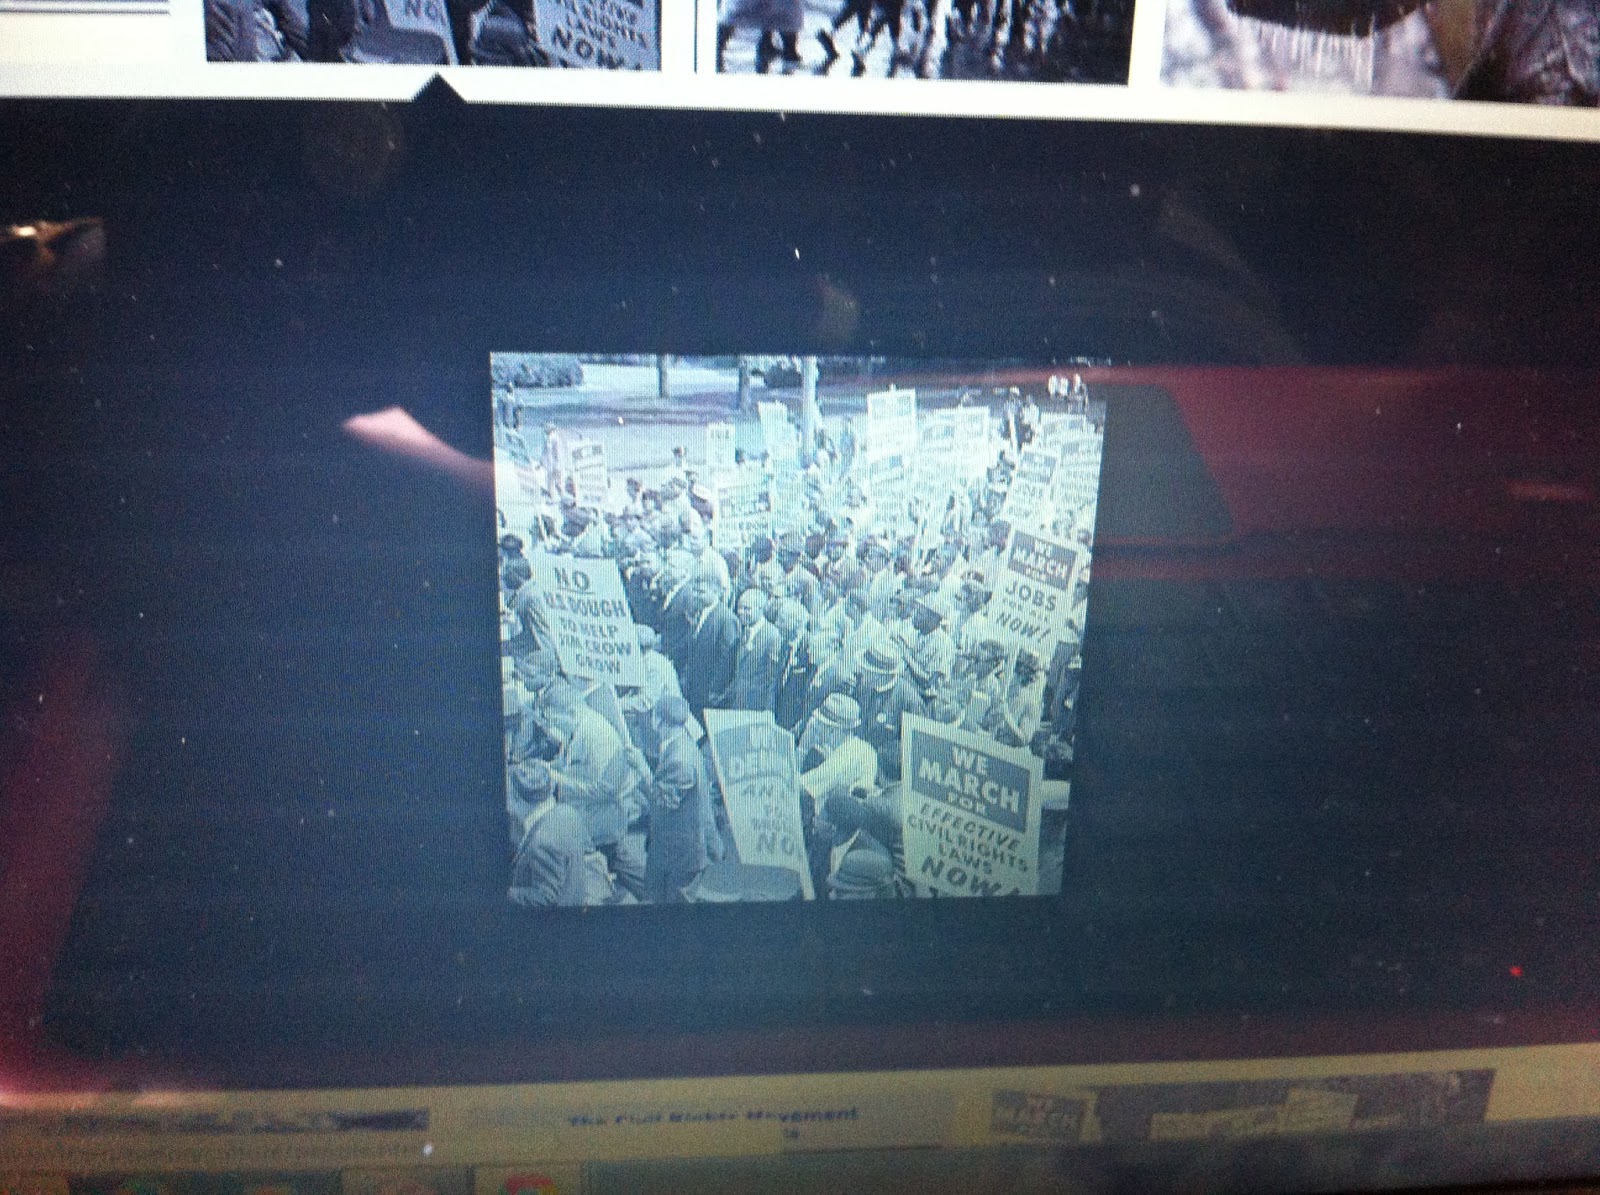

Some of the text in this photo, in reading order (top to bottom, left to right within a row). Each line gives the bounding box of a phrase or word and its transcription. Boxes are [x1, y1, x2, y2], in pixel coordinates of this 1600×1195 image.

[553, 567, 590, 591] NO
[567, 596, 627, 618] DOUGH
[1005, 581, 1057, 612] JOBS
[952, 746, 988, 775] WE
[918, 757, 1019, 813] MARCH
[948, 792, 987, 816] FOR
[920, 803, 1021, 851] EFFECTIVE
[938, 844, 993, 875] LAWS
